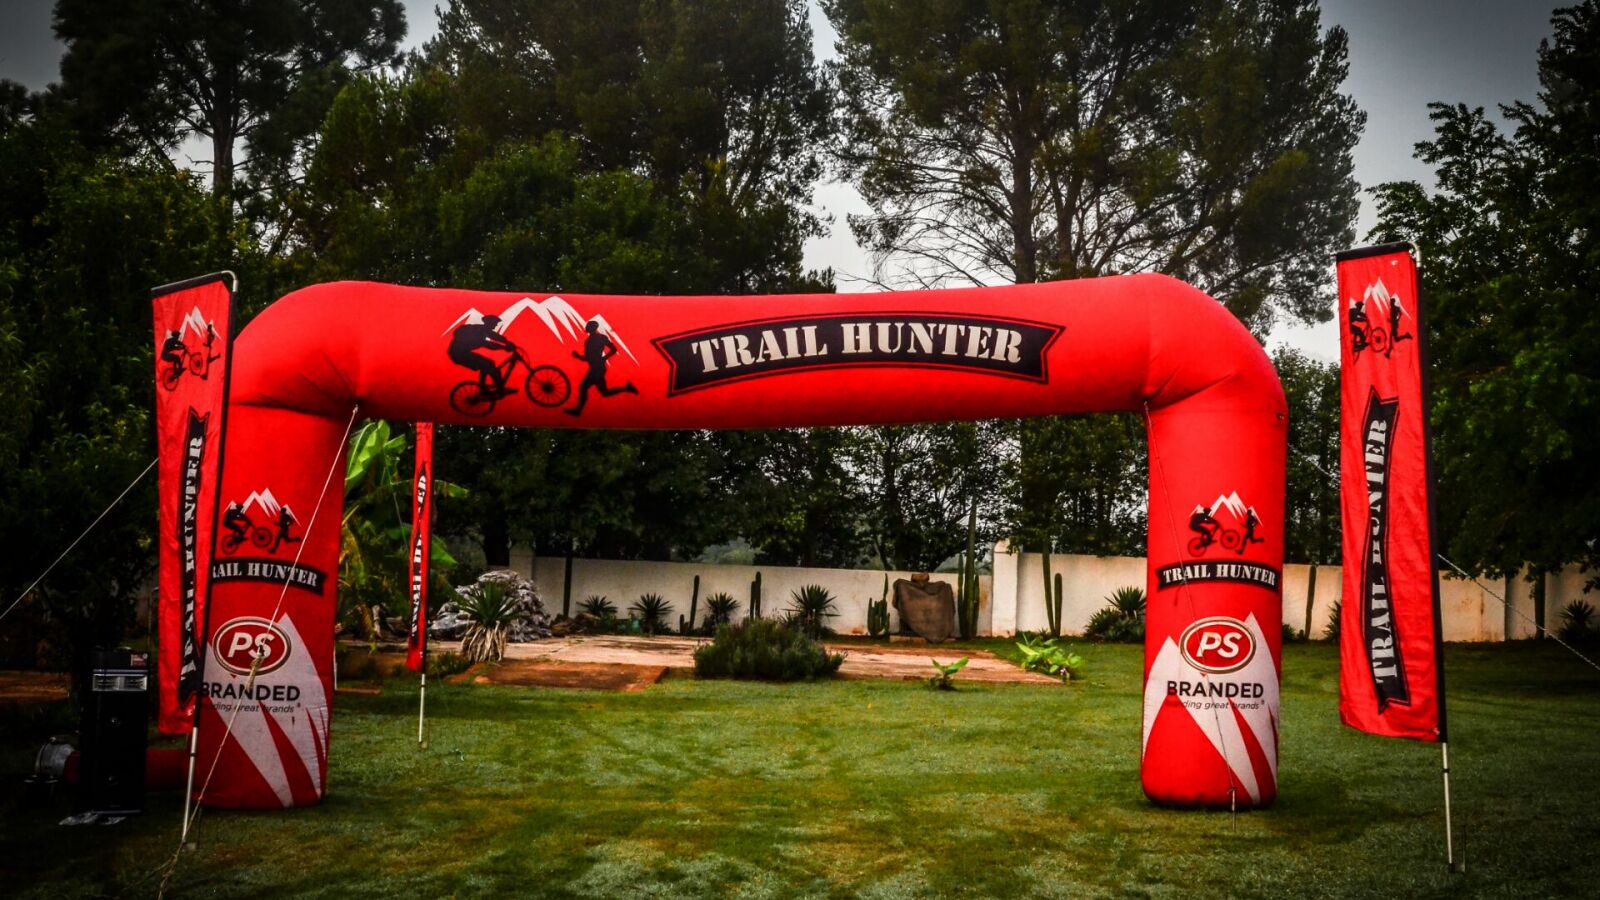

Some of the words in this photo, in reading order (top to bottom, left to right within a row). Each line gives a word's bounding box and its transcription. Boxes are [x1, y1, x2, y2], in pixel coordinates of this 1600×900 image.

[691, 325, 828, 373] TRAIL
[840, 322, 1023, 364] HUNTER
[212, 562, 242, 579] AIL
[247, 562, 318, 587] HUNTER
[1163, 564, 1211, 584] TRAIL
[1216, 564, 1276, 587] HUNTER
[1371, 576, 1398, 685] TRAIL
[227, 631, 275, 660] PS
[1196, 631, 1243, 659] PS
[201, 682, 301, 702] BRANDED
[1166, 680, 1264, 699] BRANDED
[1204, 700, 1229, 710] great
